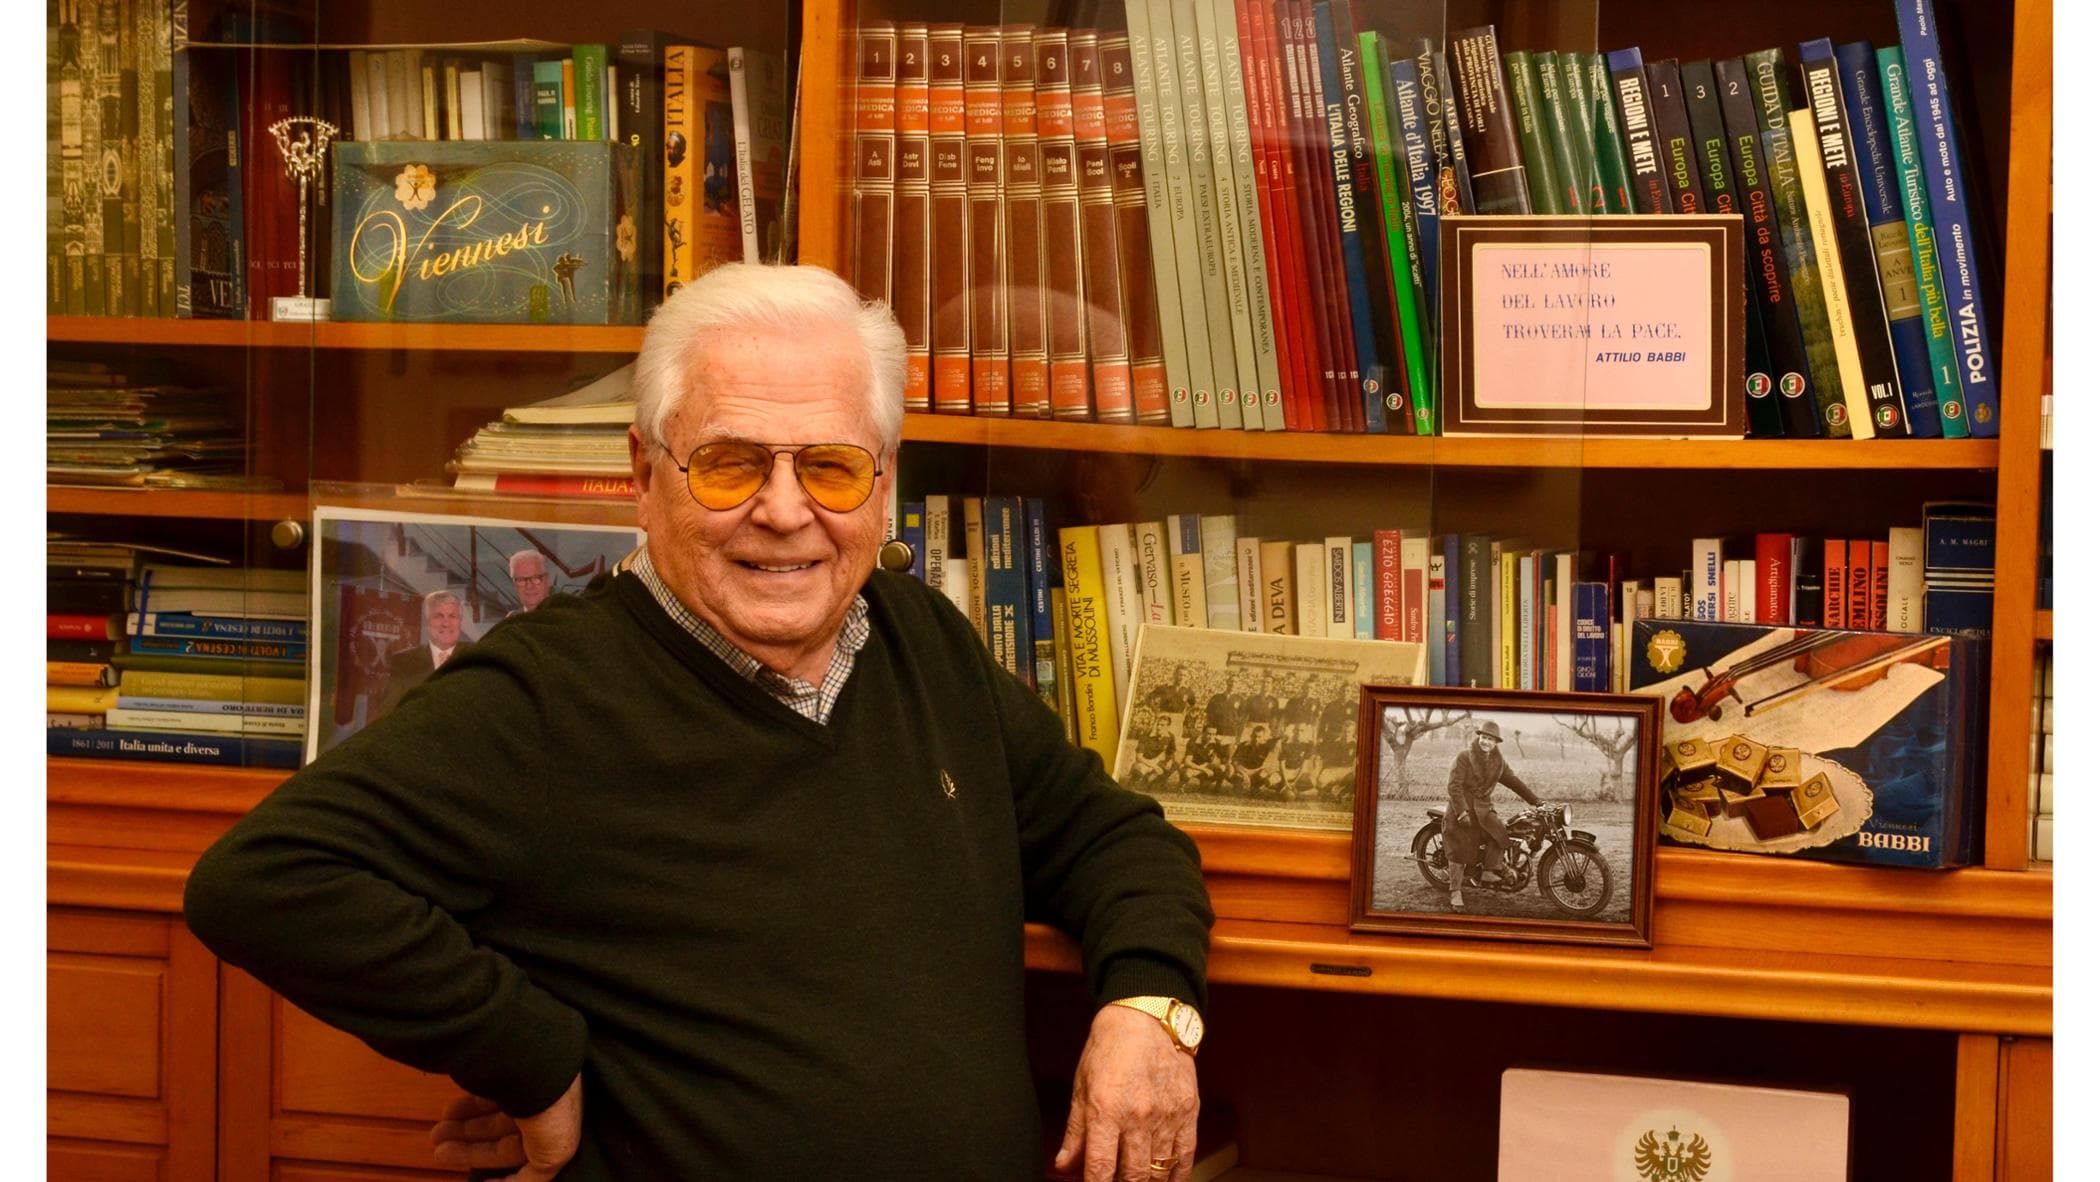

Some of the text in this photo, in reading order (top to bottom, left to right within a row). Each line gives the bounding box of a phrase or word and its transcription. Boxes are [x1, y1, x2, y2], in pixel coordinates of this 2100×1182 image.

[1281, 17, 1291, 39] 1
[1293, 18, 1304, 40] 2
[1305, 17, 1316, 39] 3
[873, 52, 880, 64] 1
[906, 52, 915, 65] 2
[941, 54, 950, 67] 3
[977, 55, 987, 68] 4
[1013, 55, 1022, 68] 5
[1046, 57, 1056, 70] 6
[1082, 59, 1091, 72] 7
[1113, 62, 1122, 74] 8
[1203, 37, 1220, 96] ATLANTE
[1224, 36, 1241, 95] ATLANTE
[666, 50, 686, 127] ITALIA
[1417, 52, 1441, 116] VIAGGIO
[1661, 84, 1669, 98] 1
[1696, 85, 1705, 99] 3
[1728, 81, 1739, 96] 2
[1135, 35, 1161, 209] ATLANTE TOURING ITALIA
[1155, 38, 1184, 221] ATLANTE TOURING EUROPA
[1210, 104, 1228, 164] TOURING
[1232, 101, 1250, 163] TOURING
[1341, 48, 1370, 193] Atlante Geografico Italia
[1445, 97, 1464, 161] PAESE MIO
[1619, 77, 1657, 175] REGIONI E METE
[1757, 62, 1795, 187] GUIDA D'ITALIA
[1809, 68, 1847, 169] REGIONI E METE
[1922, 58, 1956, 201] Auto e moto dal 1945 ad oggi
[1180, 34, 1217, 277] ATLANTE TOURING PAESI EXTRAEUROPEI
[1396, 79, 1437, 217] Atlante d'Italia 1997
[1856, 70, 1892, 215] Grande Enciclopedia Universale
[975, 156, 995, 165] Feng
[976, 164, 994, 172] Invo
[1327, 104, 1356, 233] L'ITALIA DELLE REGIONI
[1670, 137, 1689, 189] Europa
[1706, 138, 1725, 190] Europa
[740, 187, 754, 236] GELATO
[1222, 186, 1232, 219] STORIA
[1243, 184, 1255, 215] STORIA
[1568, 186, 1577, 208] 1
[1592, 186, 1607, 208] 2
[1618, 187, 1628, 208] 1
[1886, 63, 1947, 340] Grande Atlante Turistico dell'Italia più bella
[1405, 222, 1412, 232] un
[1739, 135, 1782, 304] Europa Città da scoprire
[1225, 221, 1237, 254] ANTICA
[1248, 218, 1261, 265] MODERNA
[1406, 233, 1415, 252] anno
[351, 195, 549, 316] Viennesi
[1409, 252, 1418, 260] di
[177, 284, 191, 311] TCI
[1231, 264, 1244, 315] MEDIEVALE
[1502, 293, 1616, 309] DEL LAVORO
[1951, 223, 1987, 385] POLIZIA in movimento
[1255, 275, 1272, 355] CONTEMPORANEA
[1601, 323, 1622, 339] LA
[1632, 322, 1682, 339] PACE.
[1595, 351, 1686, 363] ATTILIO BABBI
[1941, 366, 1952, 385] 1
[991, 534, 1001, 570] edizioni
[1002, 507, 1012, 570] mediterranee
[1382, 539, 1394, 568] EZIO
[1065, 541, 1080, 594] SEGRETA
[1143, 532, 1158, 589] Gervaso
[1470, 559, 1478, 589] imprese
[1708, 552, 1716, 587] SNELLI
[1270, 577, 1285, 620] DEVA
[1334, 584, 1344, 622] ALBERTINI
[1384, 571, 1395, 625] GREGGIO
[1469, 589, 1477, 598] di
[992, 605, 1002, 631] DALLA
[1004, 604, 1014, 617] X
[1071, 597, 1084, 640] MORTE
[1410, 607, 1418, 631] Sandro
[185, 642, 194, 653] 2
[195, 642, 236, 654] CESENA
[1077, 642, 1085, 650] E
[1083, 597, 1100, 678] DI MUSSOLINI
[1077, 652, 1088, 679] VITA
[1086, 683, 1098, 741] Franco Bandini
[119, 738, 221, 756] Italia unita e diversa
[1858, 831, 1931, 853] BABBI
